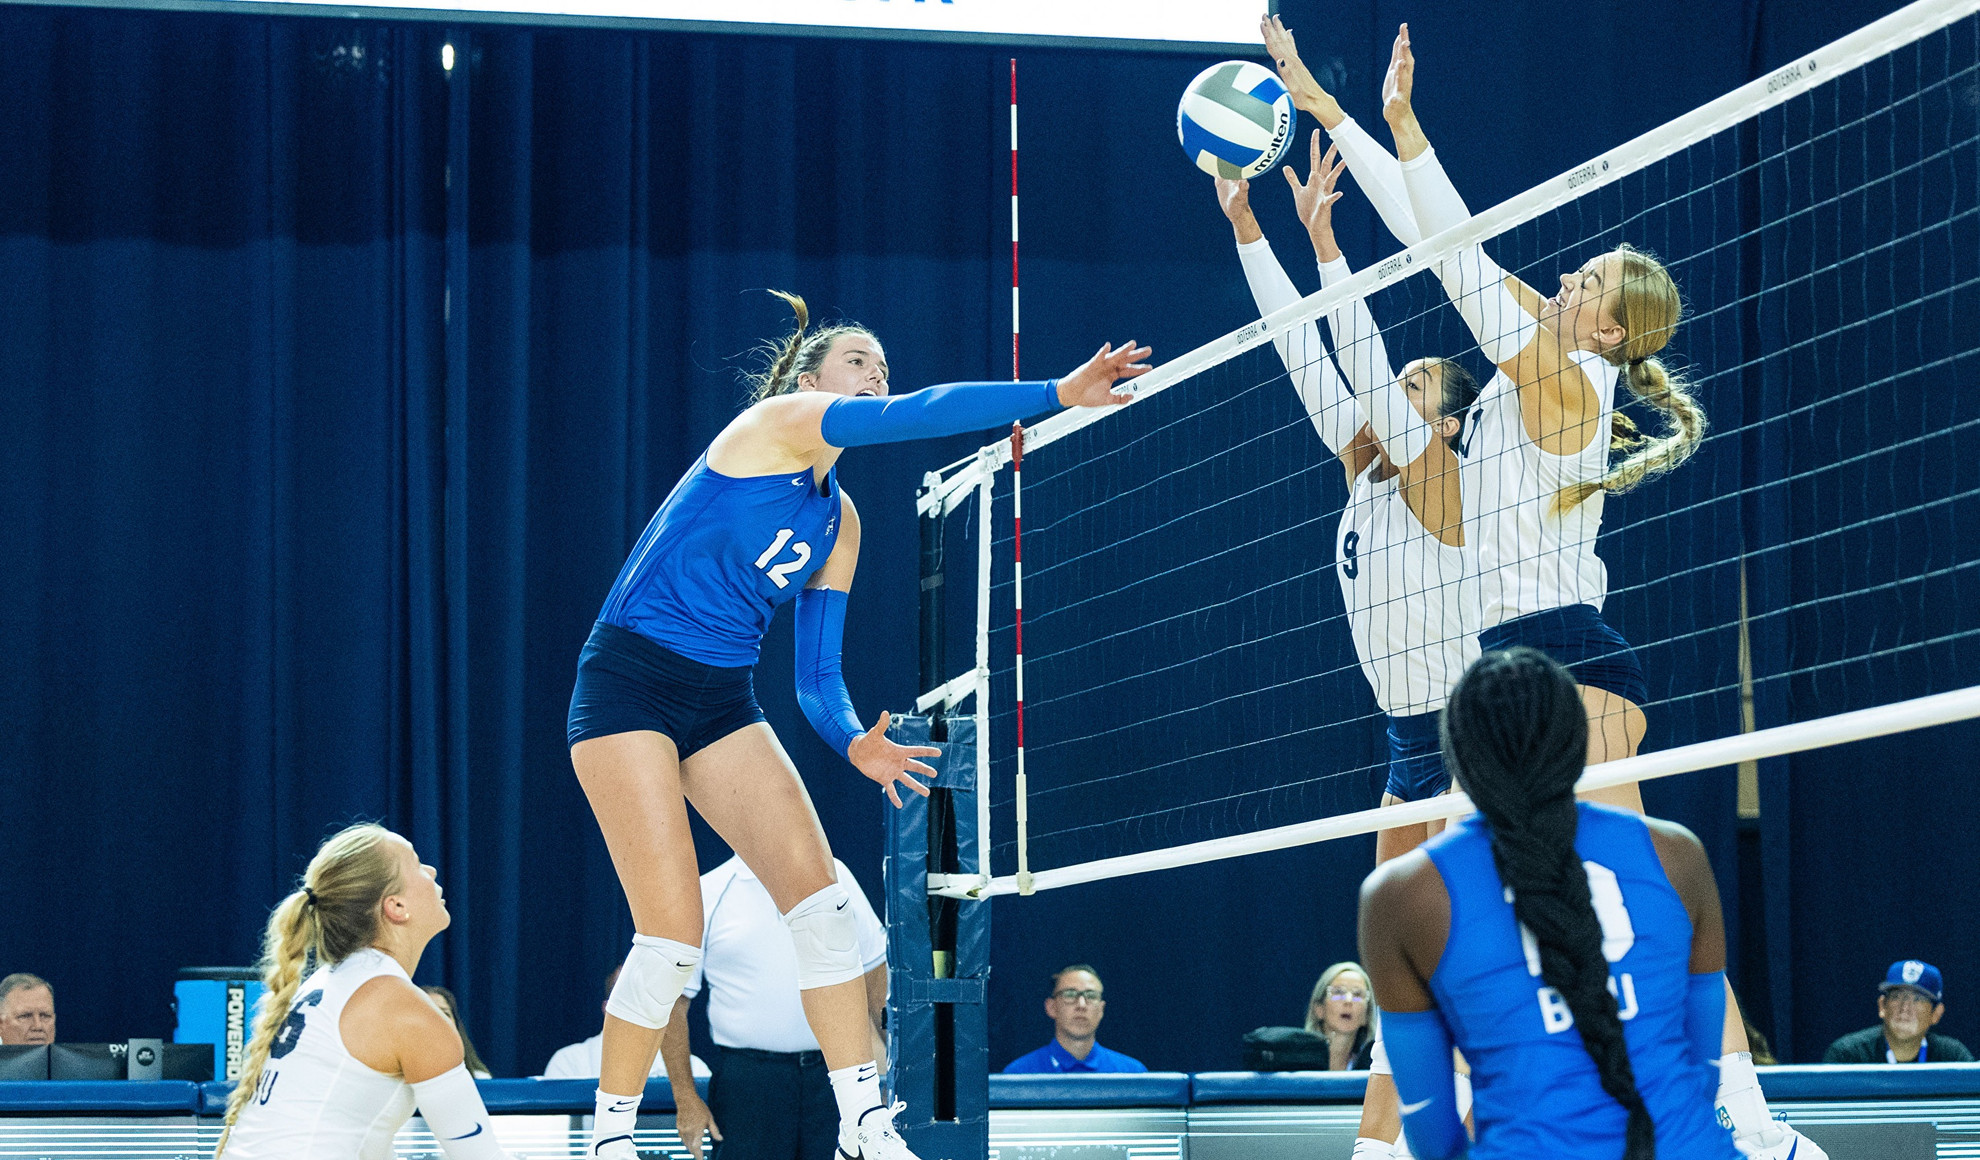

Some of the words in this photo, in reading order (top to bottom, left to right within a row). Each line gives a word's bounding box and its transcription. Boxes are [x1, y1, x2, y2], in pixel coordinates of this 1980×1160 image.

[1254, 112, 1288, 172] molten
[754, 528, 812, 590] 12
[1343, 530, 1360, 580] 9
[226, 988, 245, 1081] POWERAD
[1537, 972, 1640, 1035] BU
